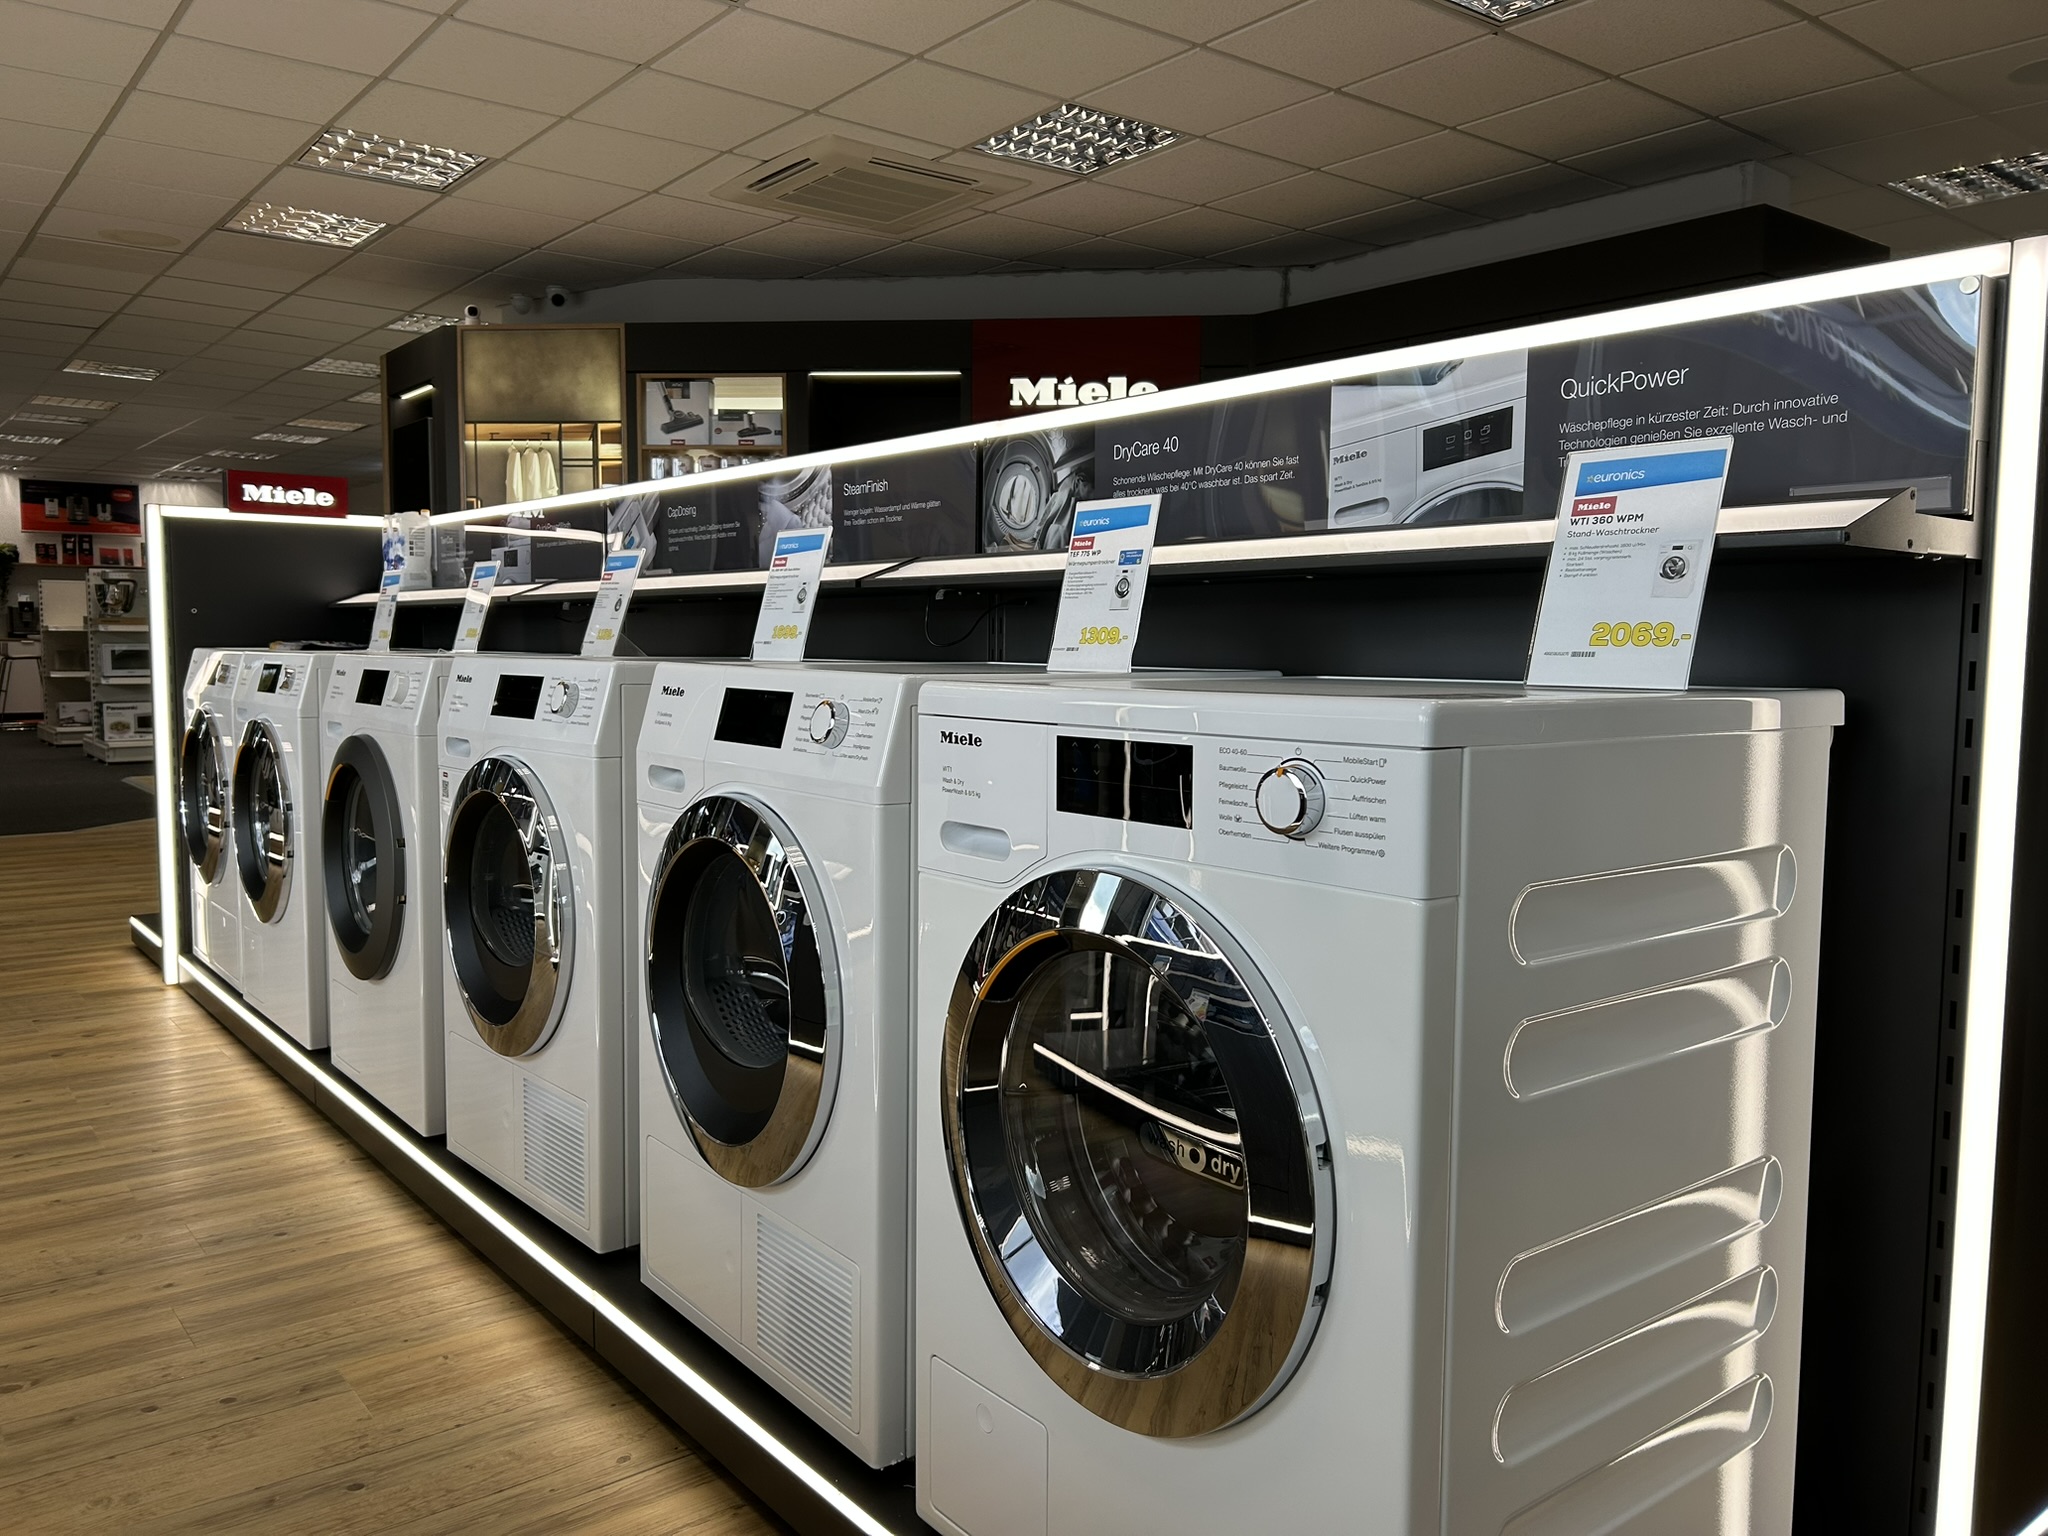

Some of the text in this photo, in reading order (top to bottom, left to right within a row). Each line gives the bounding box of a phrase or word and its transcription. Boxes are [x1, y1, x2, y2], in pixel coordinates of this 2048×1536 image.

[1561, 367, 1689, 399] QuickPower
[1559, 393, 1839, 434] Wäschepflege in kürzester Zeit: Durch innovative
[1559, 410, 1849, 451] Technologien genießen Sie exzellente Wasch- und
[1114, 436, 1180, 462] DryCare 40
[1333, 450, 1368, 466] Miele
[1113, 454, 1299, 486] Schonende Wäschepflege: Mit DryCare 40 können Sie fast
[1594, 468, 1646, 484] euronics
[844, 478, 889, 496] SteamFinish
[1156, 486, 1169, 495] was
[1170, 483, 1180, 493] bei
[1181, 480, 1198, 491] 40°C
[1199, 478, 1231, 489] waschbar
[1232, 476, 1242, 486] ist.
[1244, 474, 1259, 485] Das
[1260, 472, 1278, 485] spart
[1280, 470, 1296, 480] Zeit.
[242, 484, 335, 507] Miele
[668, 506, 697, 519] CapDosing
[1577, 501, 1612, 512] Miele
[1084, 517, 1111, 527] euronics
[1570, 514, 1645, 527] WTI 360 WPM
[1567, 526, 1660, 539] Stand-Waschtrockner
[1079, 626, 1129, 645] 1309,-
[1589, 622, 1692, 647] 2069,-
[661, 686, 685, 697] Miele
[940, 730, 983, 748] Miele
[1232, 748, 1248, 756] 40-60
[1343, 756, 1379, 766] MobileStart
[1219, 764, 1247, 773] Baumwolle
[1219, 781, 1249, 791] Pflegeleicht
[1350, 776, 1387, 786] QuickPower
[1218, 798, 1249, 808] Feinwäsche
[1352, 795, 1387, 805] Auffrischen
[1218, 814, 1233, 822] Wolle
[1349, 812, 1369, 823] Lüften
[1218, 828, 1252, 839] Oberhemden
[1334, 828, 1386, 841] Flusen ausspülen
[1318, 842, 1340, 852] Weitere
[1211, 1154, 1241, 1184] dry
